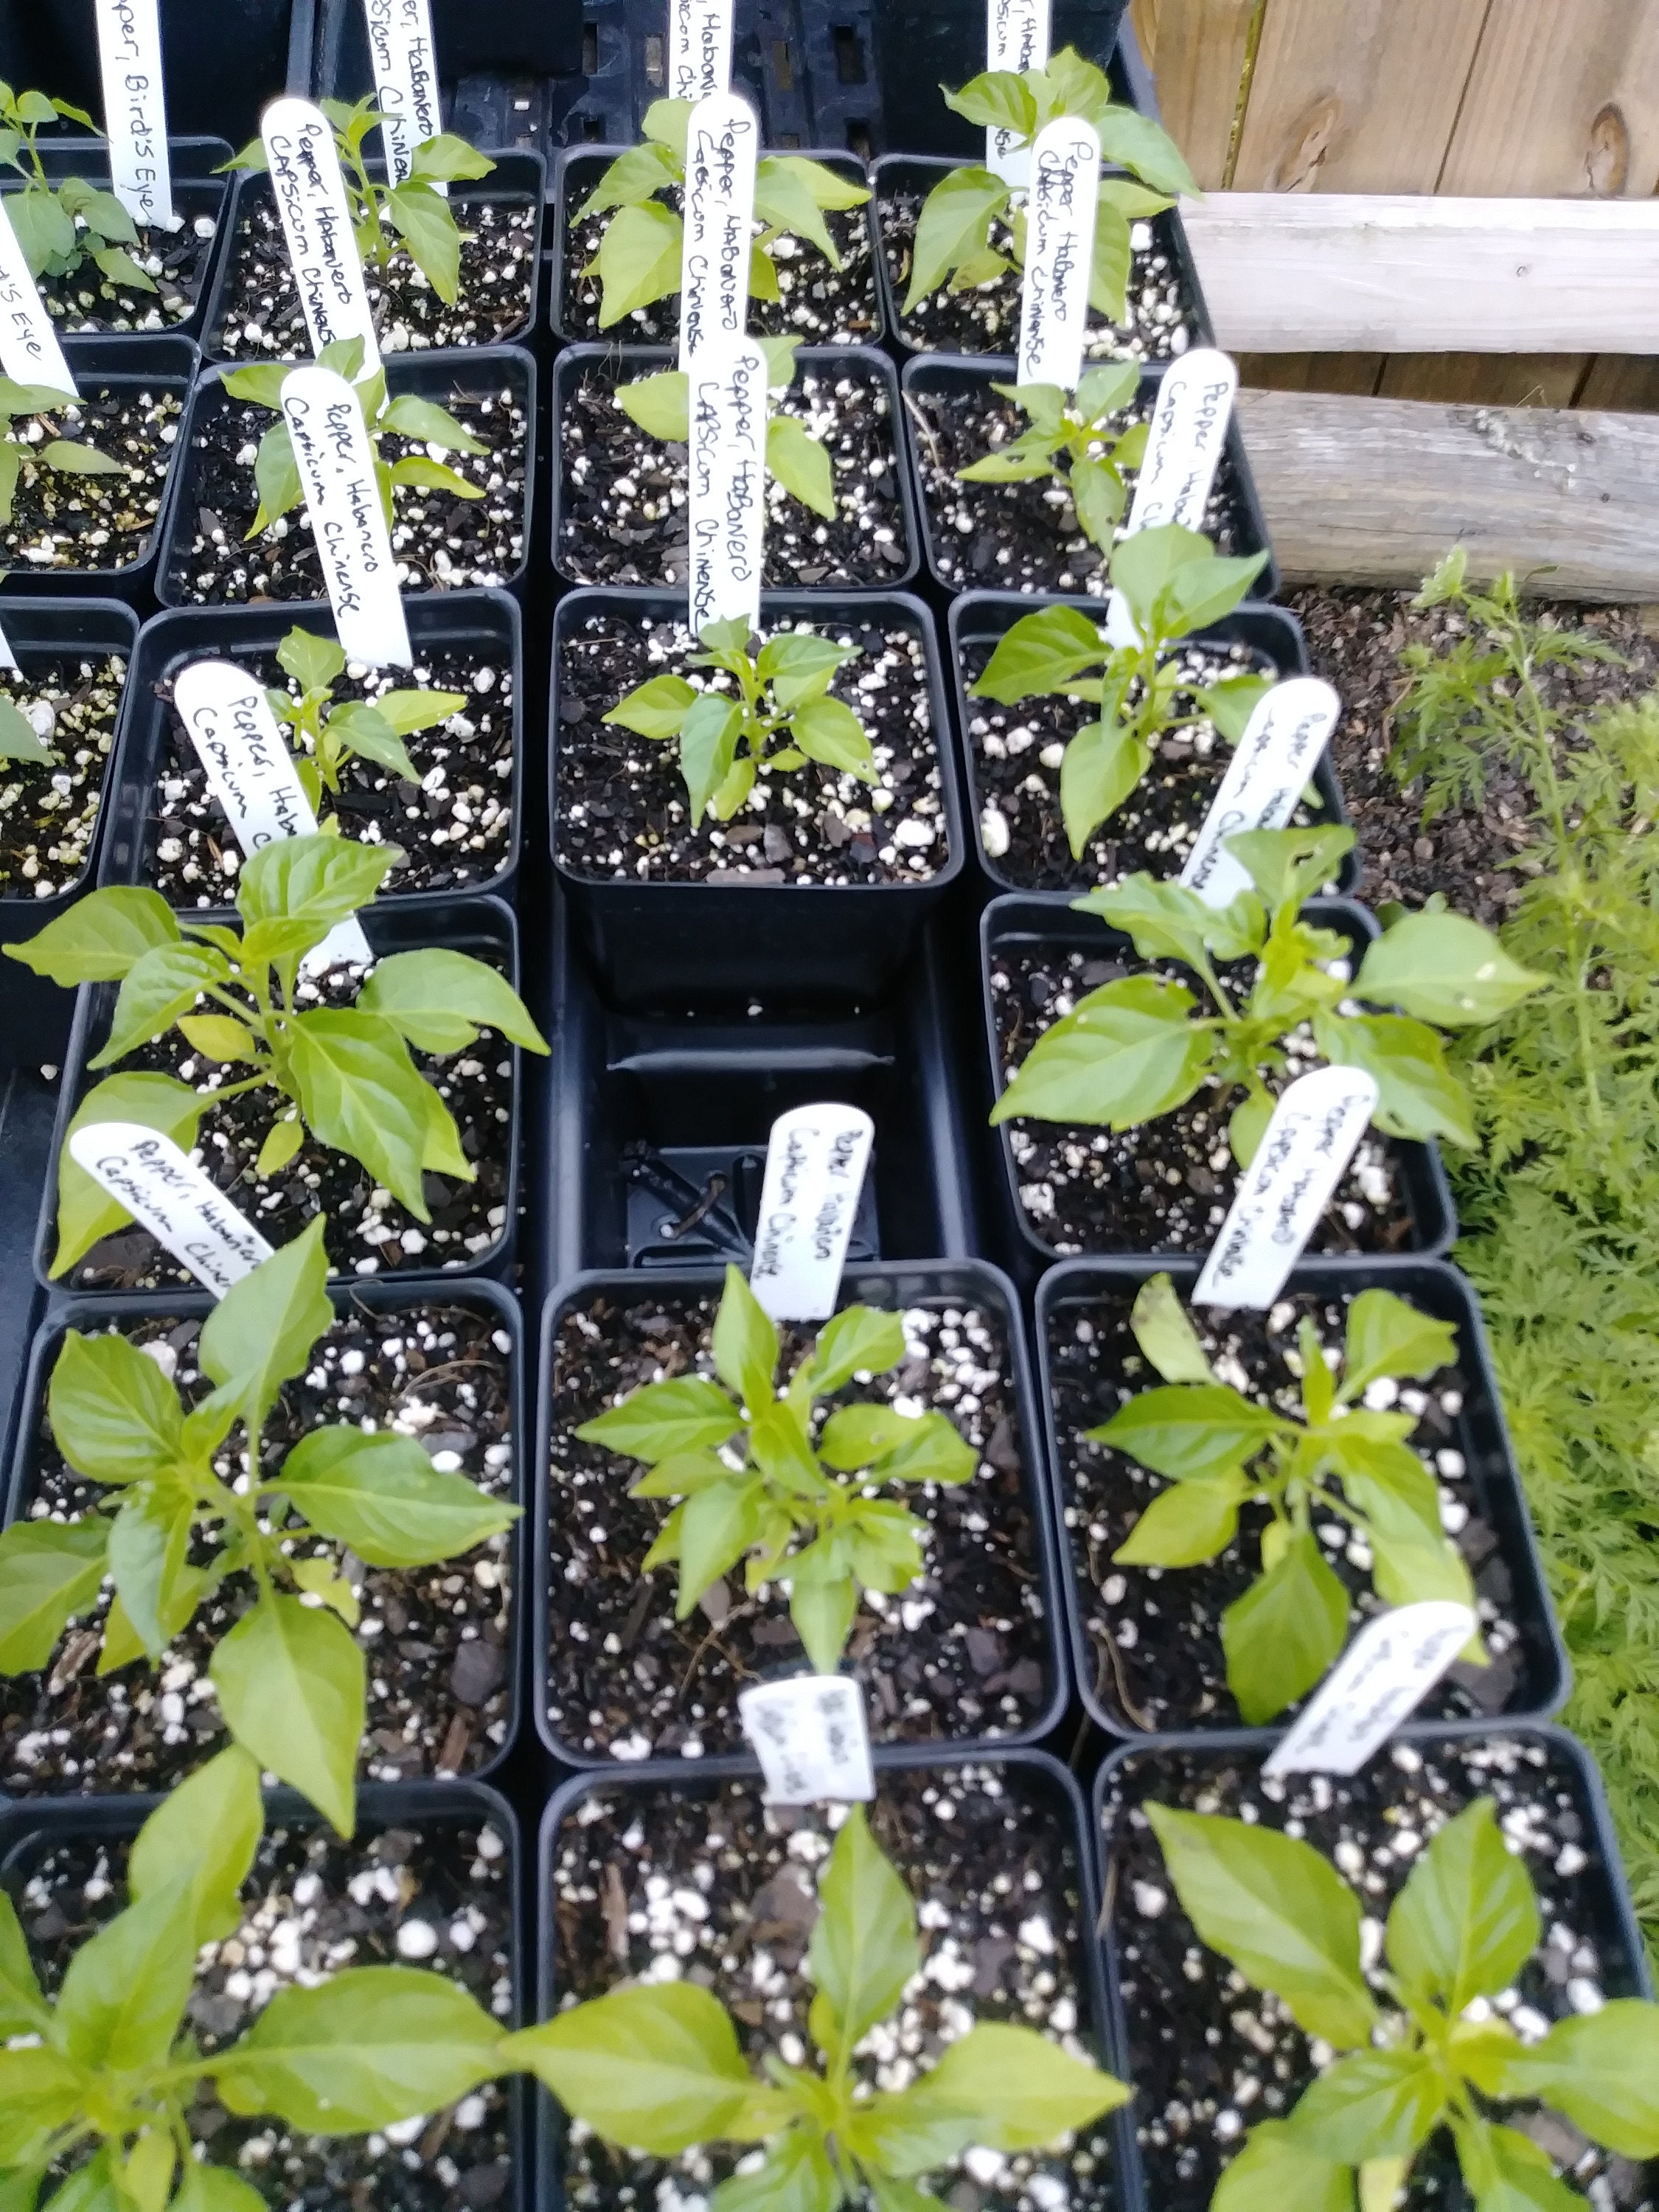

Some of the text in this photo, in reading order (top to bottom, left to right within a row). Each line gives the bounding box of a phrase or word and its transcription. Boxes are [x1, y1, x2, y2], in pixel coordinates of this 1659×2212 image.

[125, 74, 155, 159] Bird's
[127, 167, 156, 220] Eye
[11, 312, 43, 361] Eye
[724, 355, 760, 453] Pepper,
[284, 397, 361, 619] Capsicum Chinense
[324, 403, 379, 573] Pepper, Habanero
[192, 707, 247, 819] Capsicum
[227, 695, 275, 777] Pepper,
